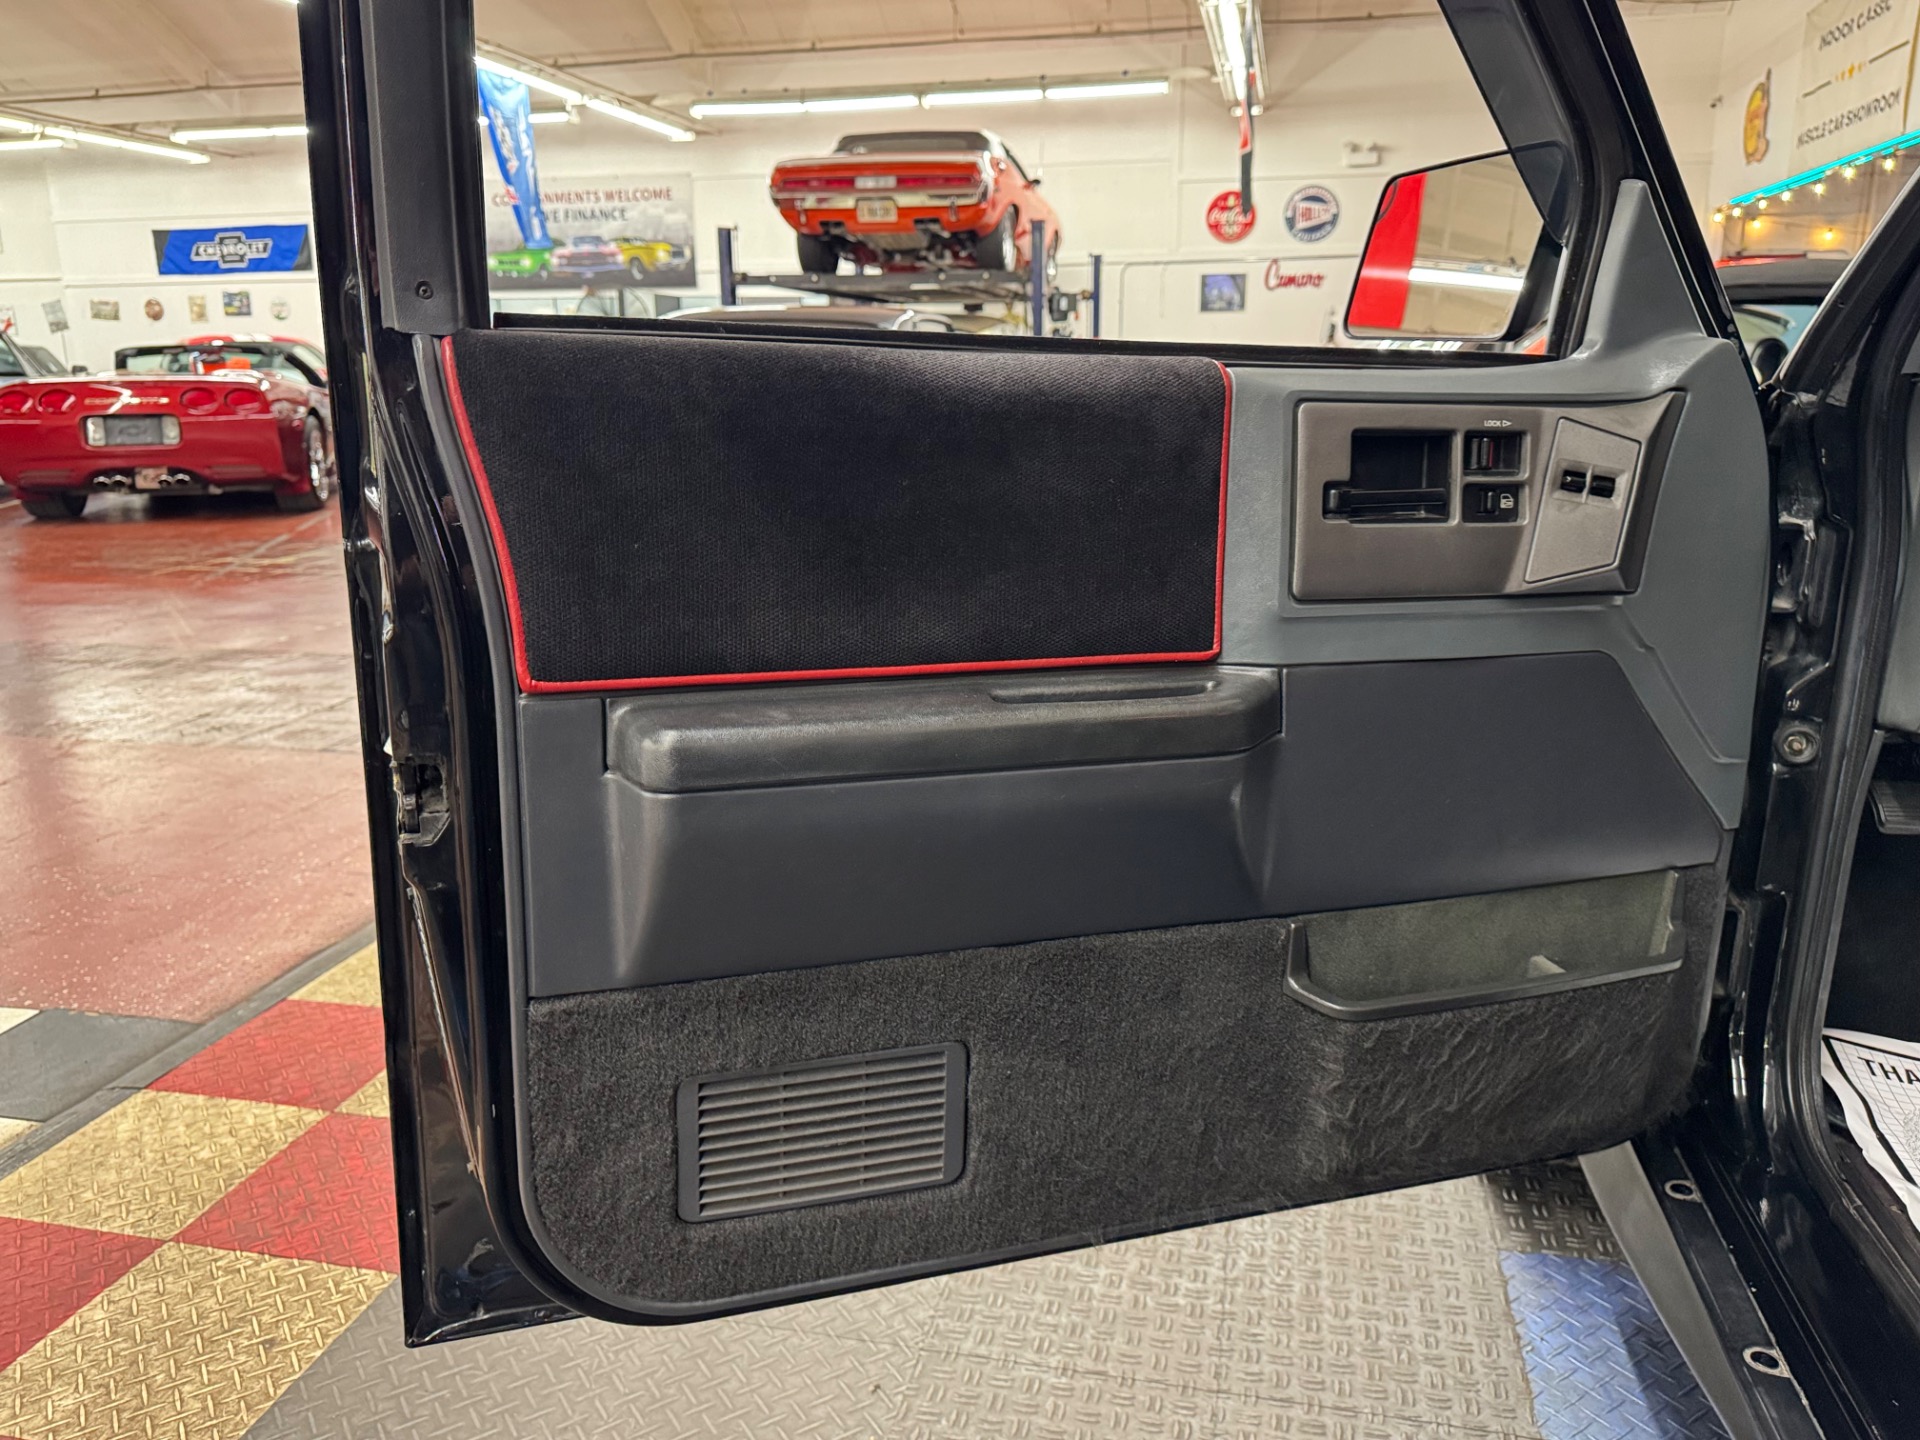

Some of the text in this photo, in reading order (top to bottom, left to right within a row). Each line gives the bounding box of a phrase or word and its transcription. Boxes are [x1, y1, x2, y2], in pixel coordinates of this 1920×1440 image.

[604, 186, 673, 203] WELCOME
[563, 206, 629, 223] FINANCE
[197, 242, 265, 257] CHEVROLET
[1265, 259, 1325, 291] Camaro
[1483, 419, 1502, 427] LOCK
